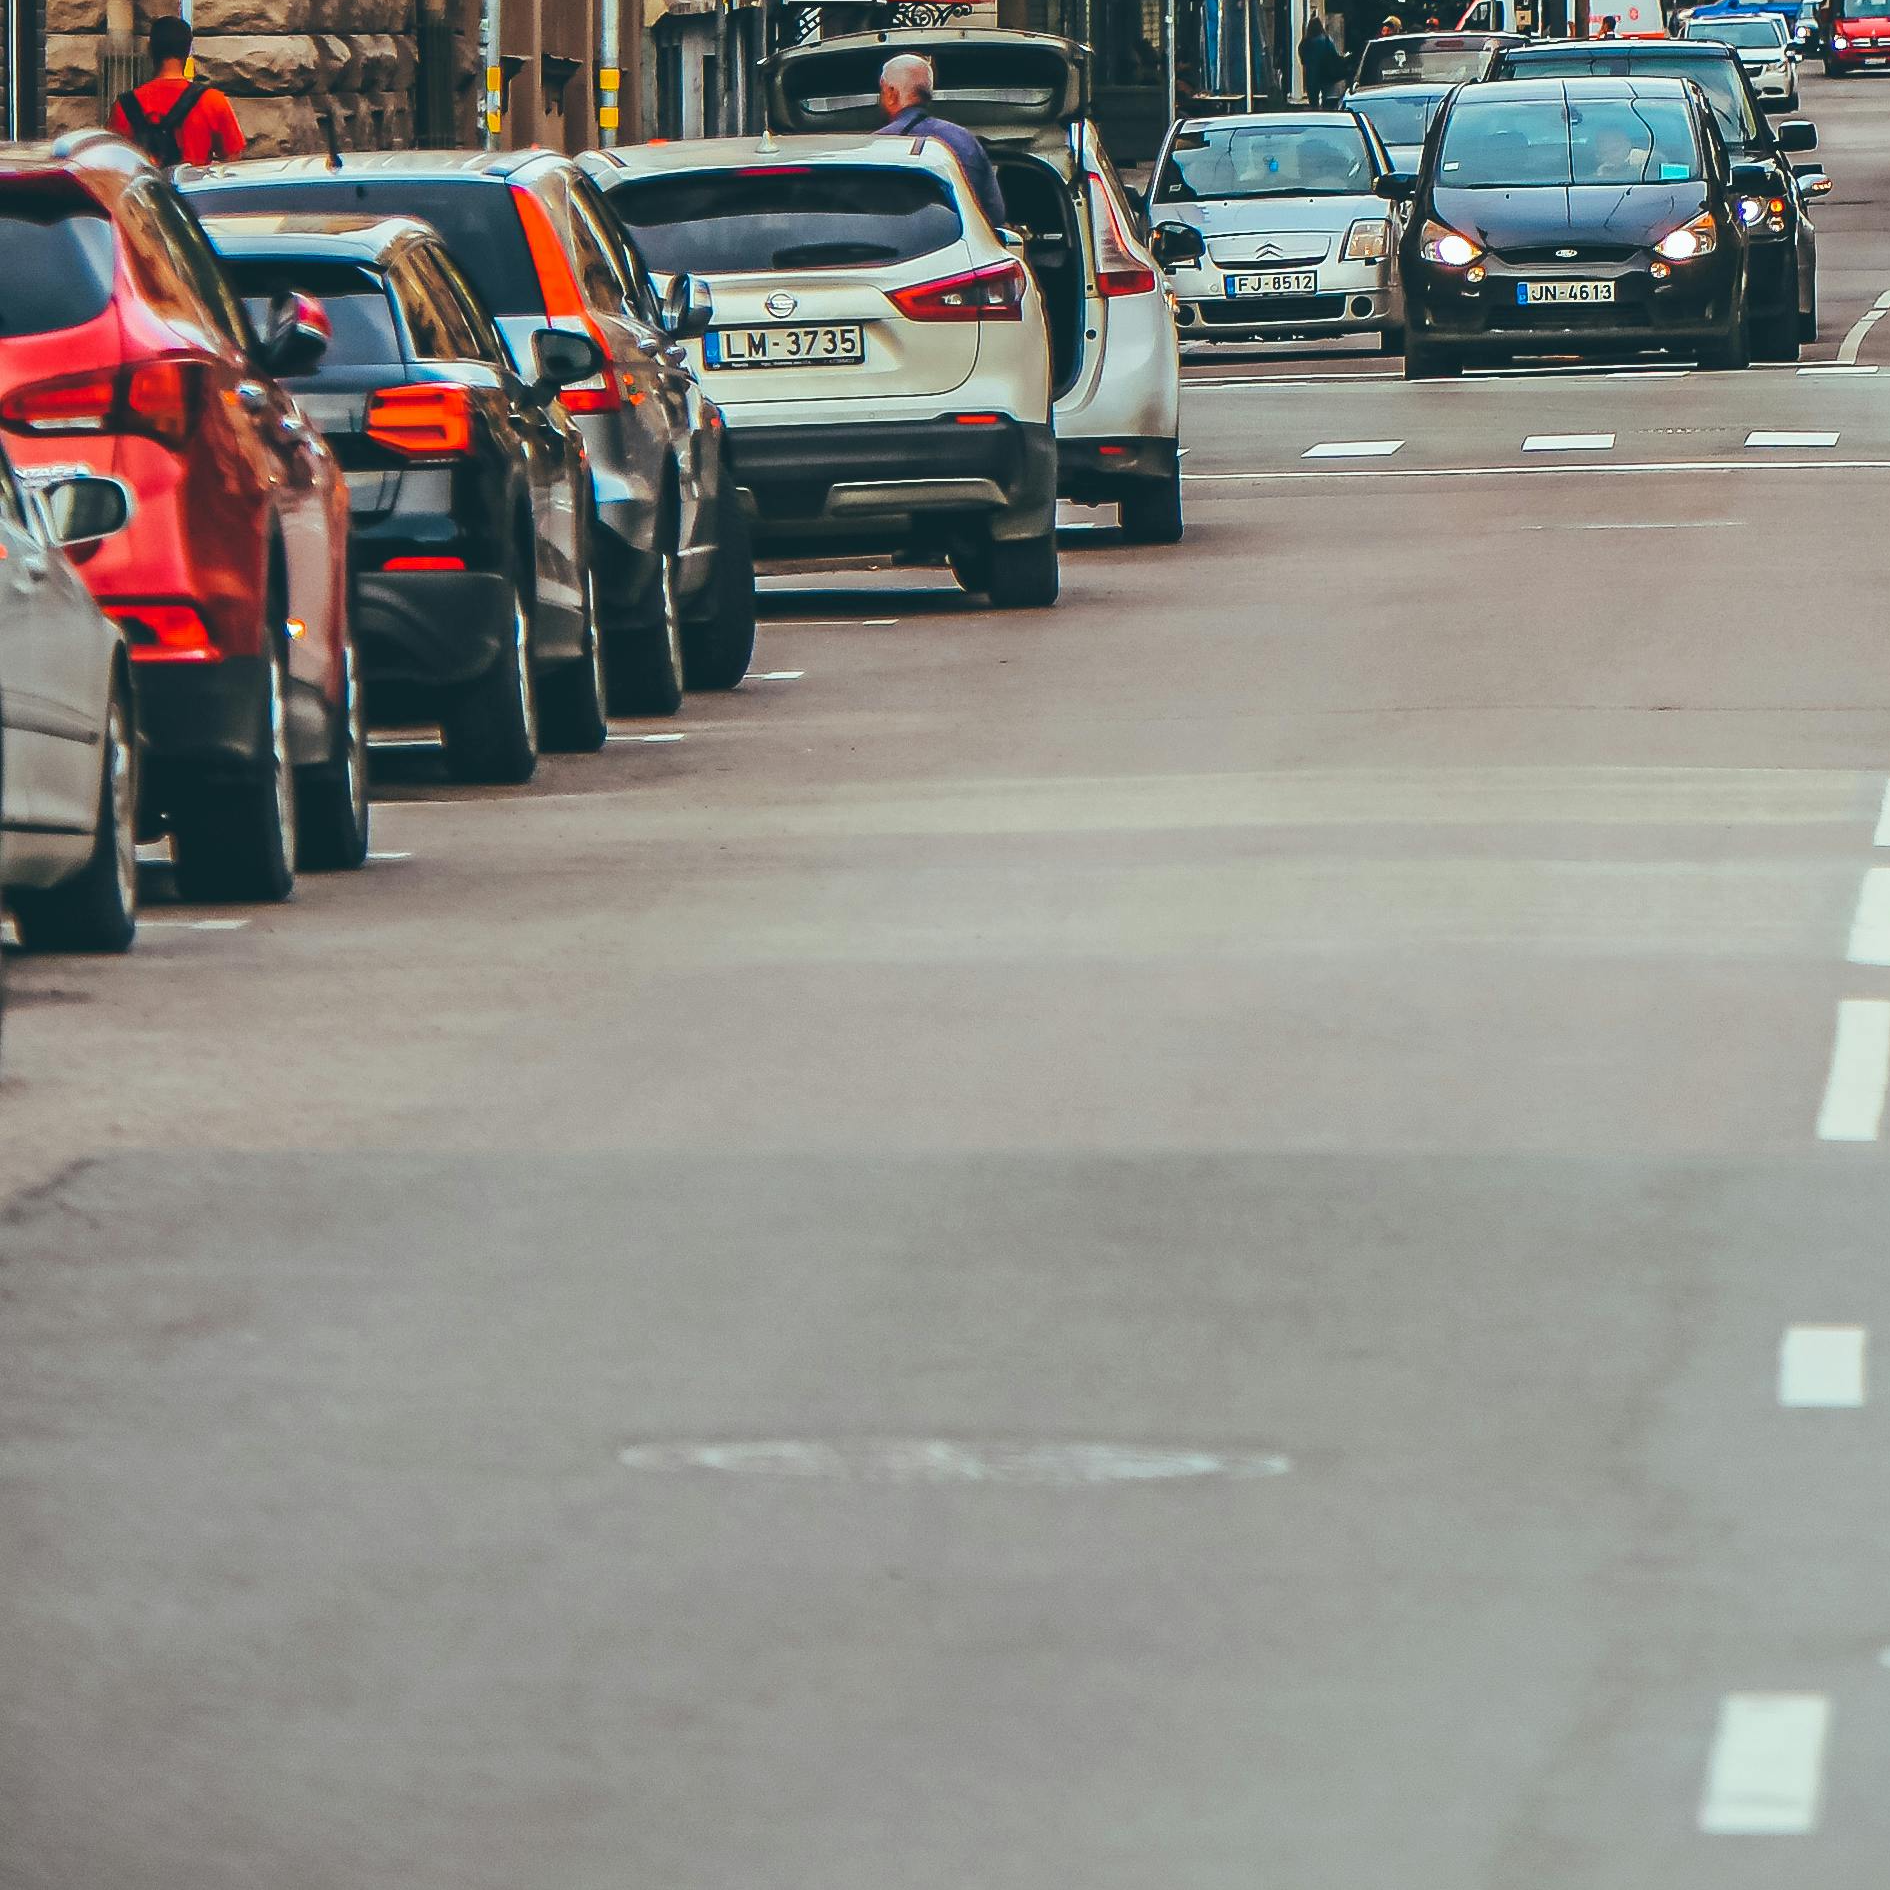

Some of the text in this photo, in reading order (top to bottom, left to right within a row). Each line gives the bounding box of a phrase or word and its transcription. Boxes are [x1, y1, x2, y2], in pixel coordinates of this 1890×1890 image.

[1238, 275, 1313, 292] FJ-8512
[1531, 284, 1612, 301] JN-4613
[726, 329, 856, 359] LM-3735
